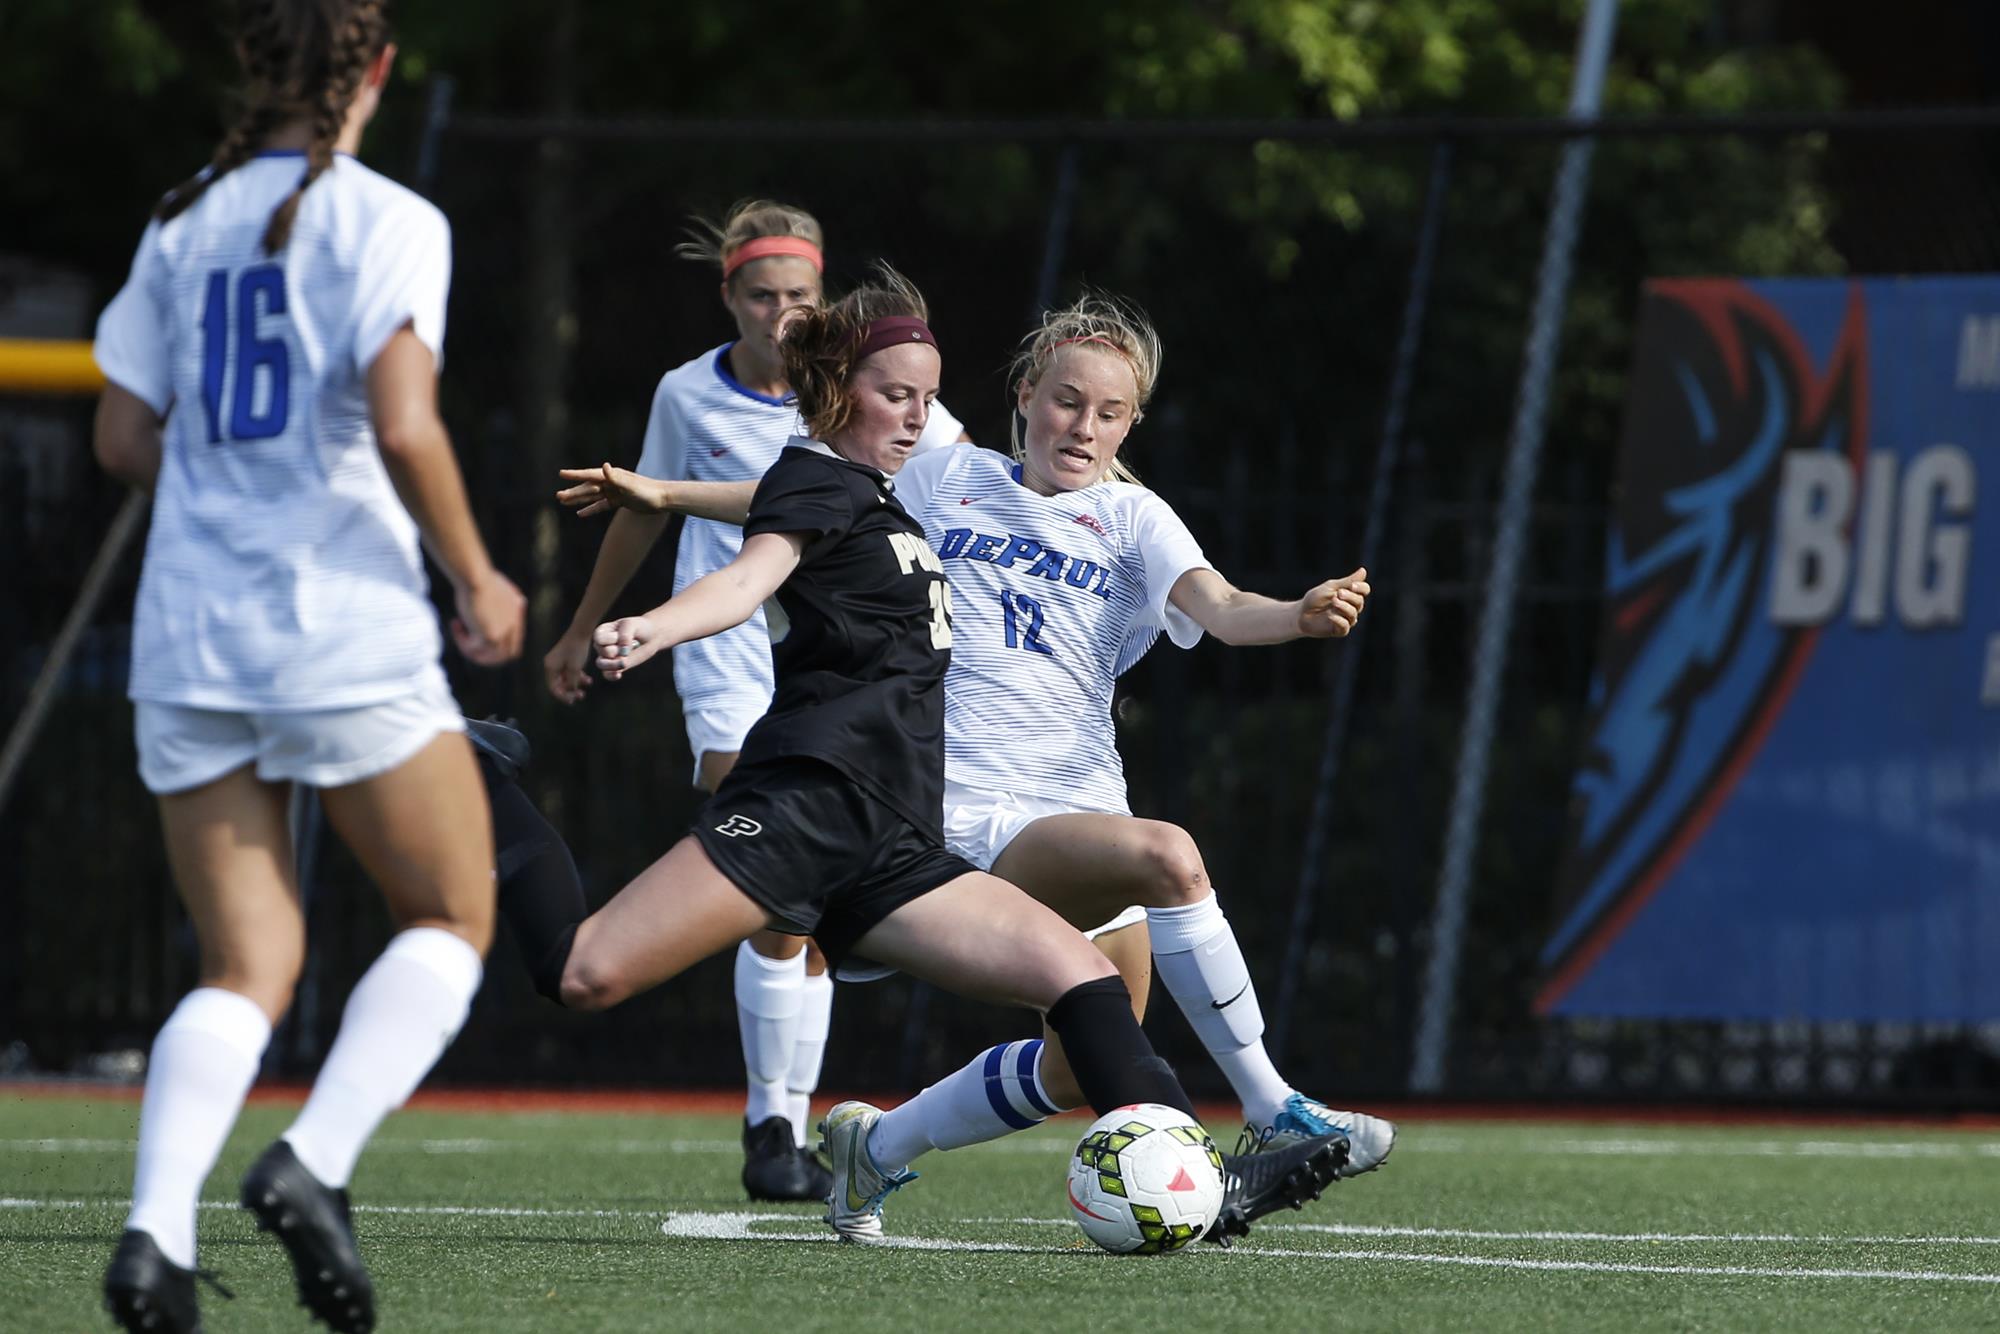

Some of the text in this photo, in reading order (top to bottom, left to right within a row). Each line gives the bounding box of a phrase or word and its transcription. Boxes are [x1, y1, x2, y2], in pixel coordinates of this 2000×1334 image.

[201, 262, 290, 445] 16
[887, 531, 944, 575] PU
[938, 527, 1112, 600] DEPAUL
[1771, 444, 1975, 630] BIG
[928, 579, 952, 650] 3
[1000, 589, 1054, 656] 12
[714, 814, 762, 837] P
